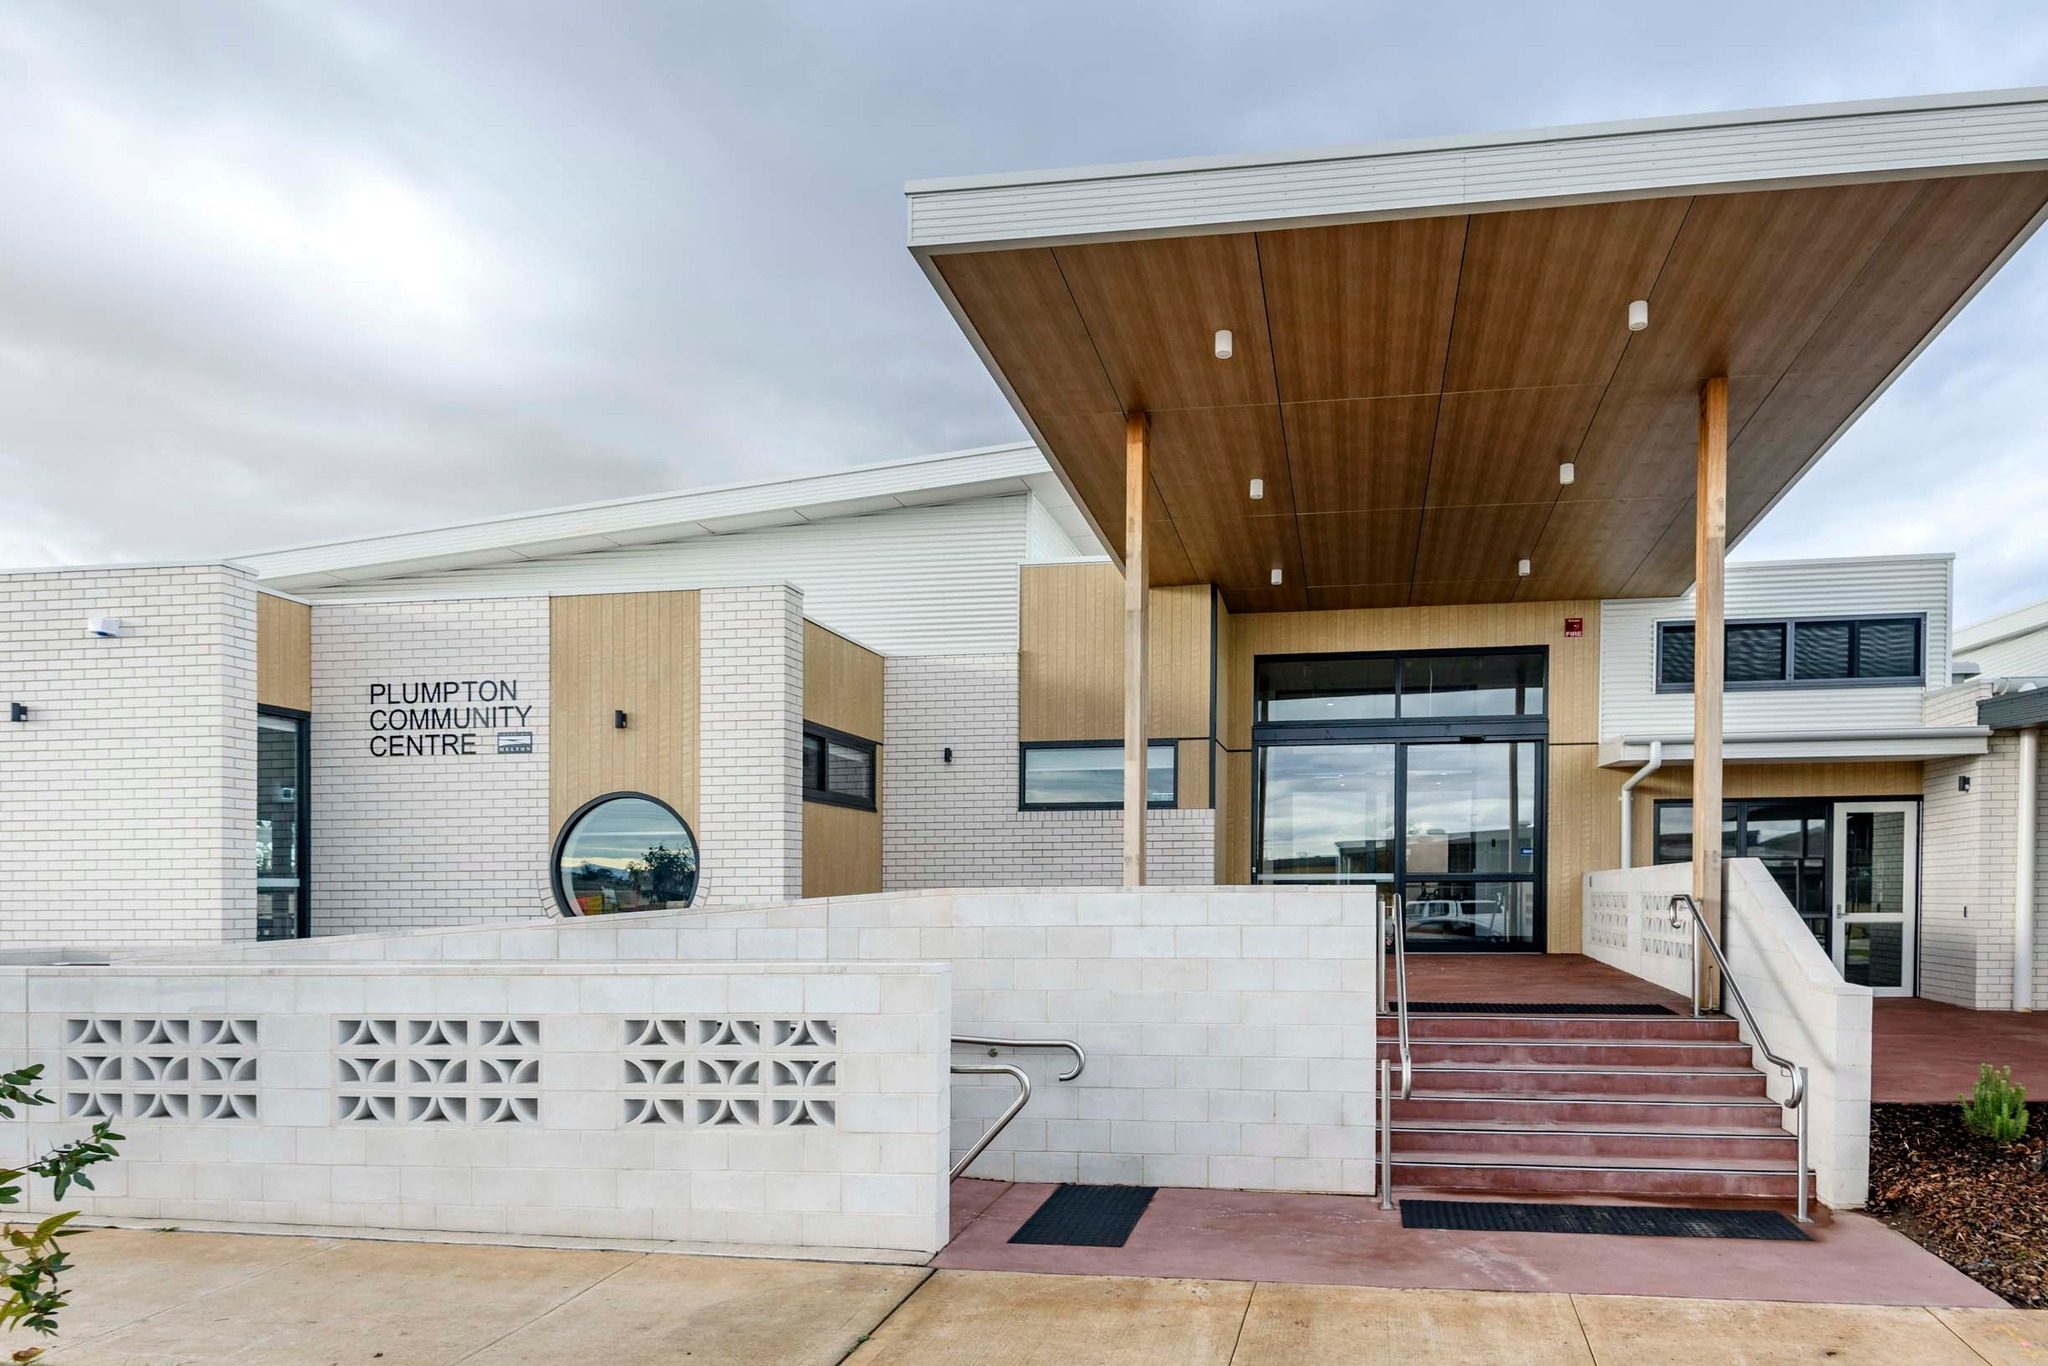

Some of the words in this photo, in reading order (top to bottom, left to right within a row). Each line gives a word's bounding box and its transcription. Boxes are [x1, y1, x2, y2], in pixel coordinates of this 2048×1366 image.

[370, 680, 517, 704] PLUMPTON
[370, 705, 532, 731] COMMUNITY
[370, 733, 476, 757] CENTRE
